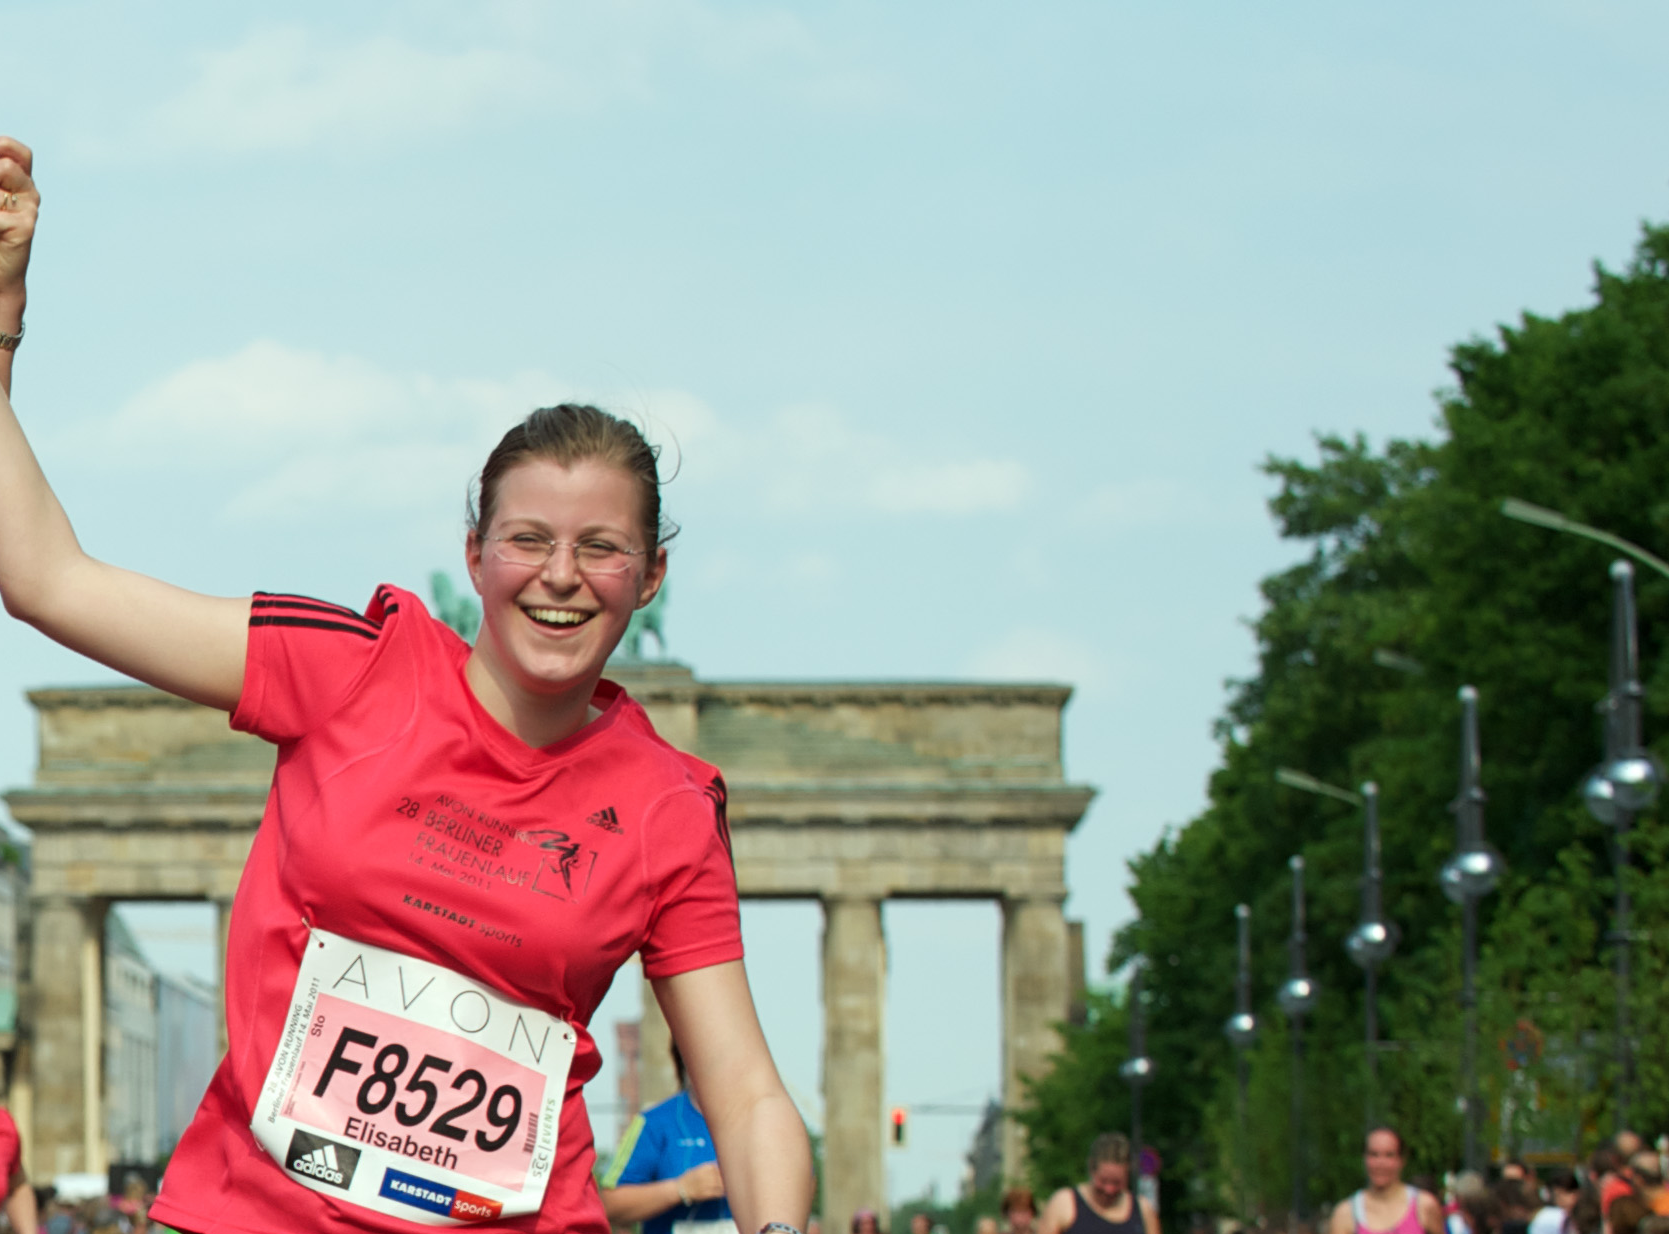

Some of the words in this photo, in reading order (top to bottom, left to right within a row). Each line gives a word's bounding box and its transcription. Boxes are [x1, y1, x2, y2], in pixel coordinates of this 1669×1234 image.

[435, 795, 476, 819] AVON
[414, 830, 531, 887] FRAUENLAUF
[423, 809, 503, 858] BERLINER
[459, 870, 491, 892] 2011
[403, 894, 478, 929] KARSTADT
[479, 922, 523, 948] sports
[281, 1037, 303, 1088] Frauenlauf
[308, 977, 321, 1000] 2011
[311, 1014, 326, 1038] Sto
[332, 954, 550, 1065] AVON
[274, 1050, 289, 1078] AVON
[283, 1003, 303, 1049] RUNNING
[312, 1026, 523, 1152] F8529
[343, 1116, 459, 1170] Elisabeth
[541, 1098, 556, 1144] EVENTS
[293, 1159, 344, 1185] adidas
[390, 1180, 453, 1207] KARSTADT
[454, 1199, 493, 1218] sports
